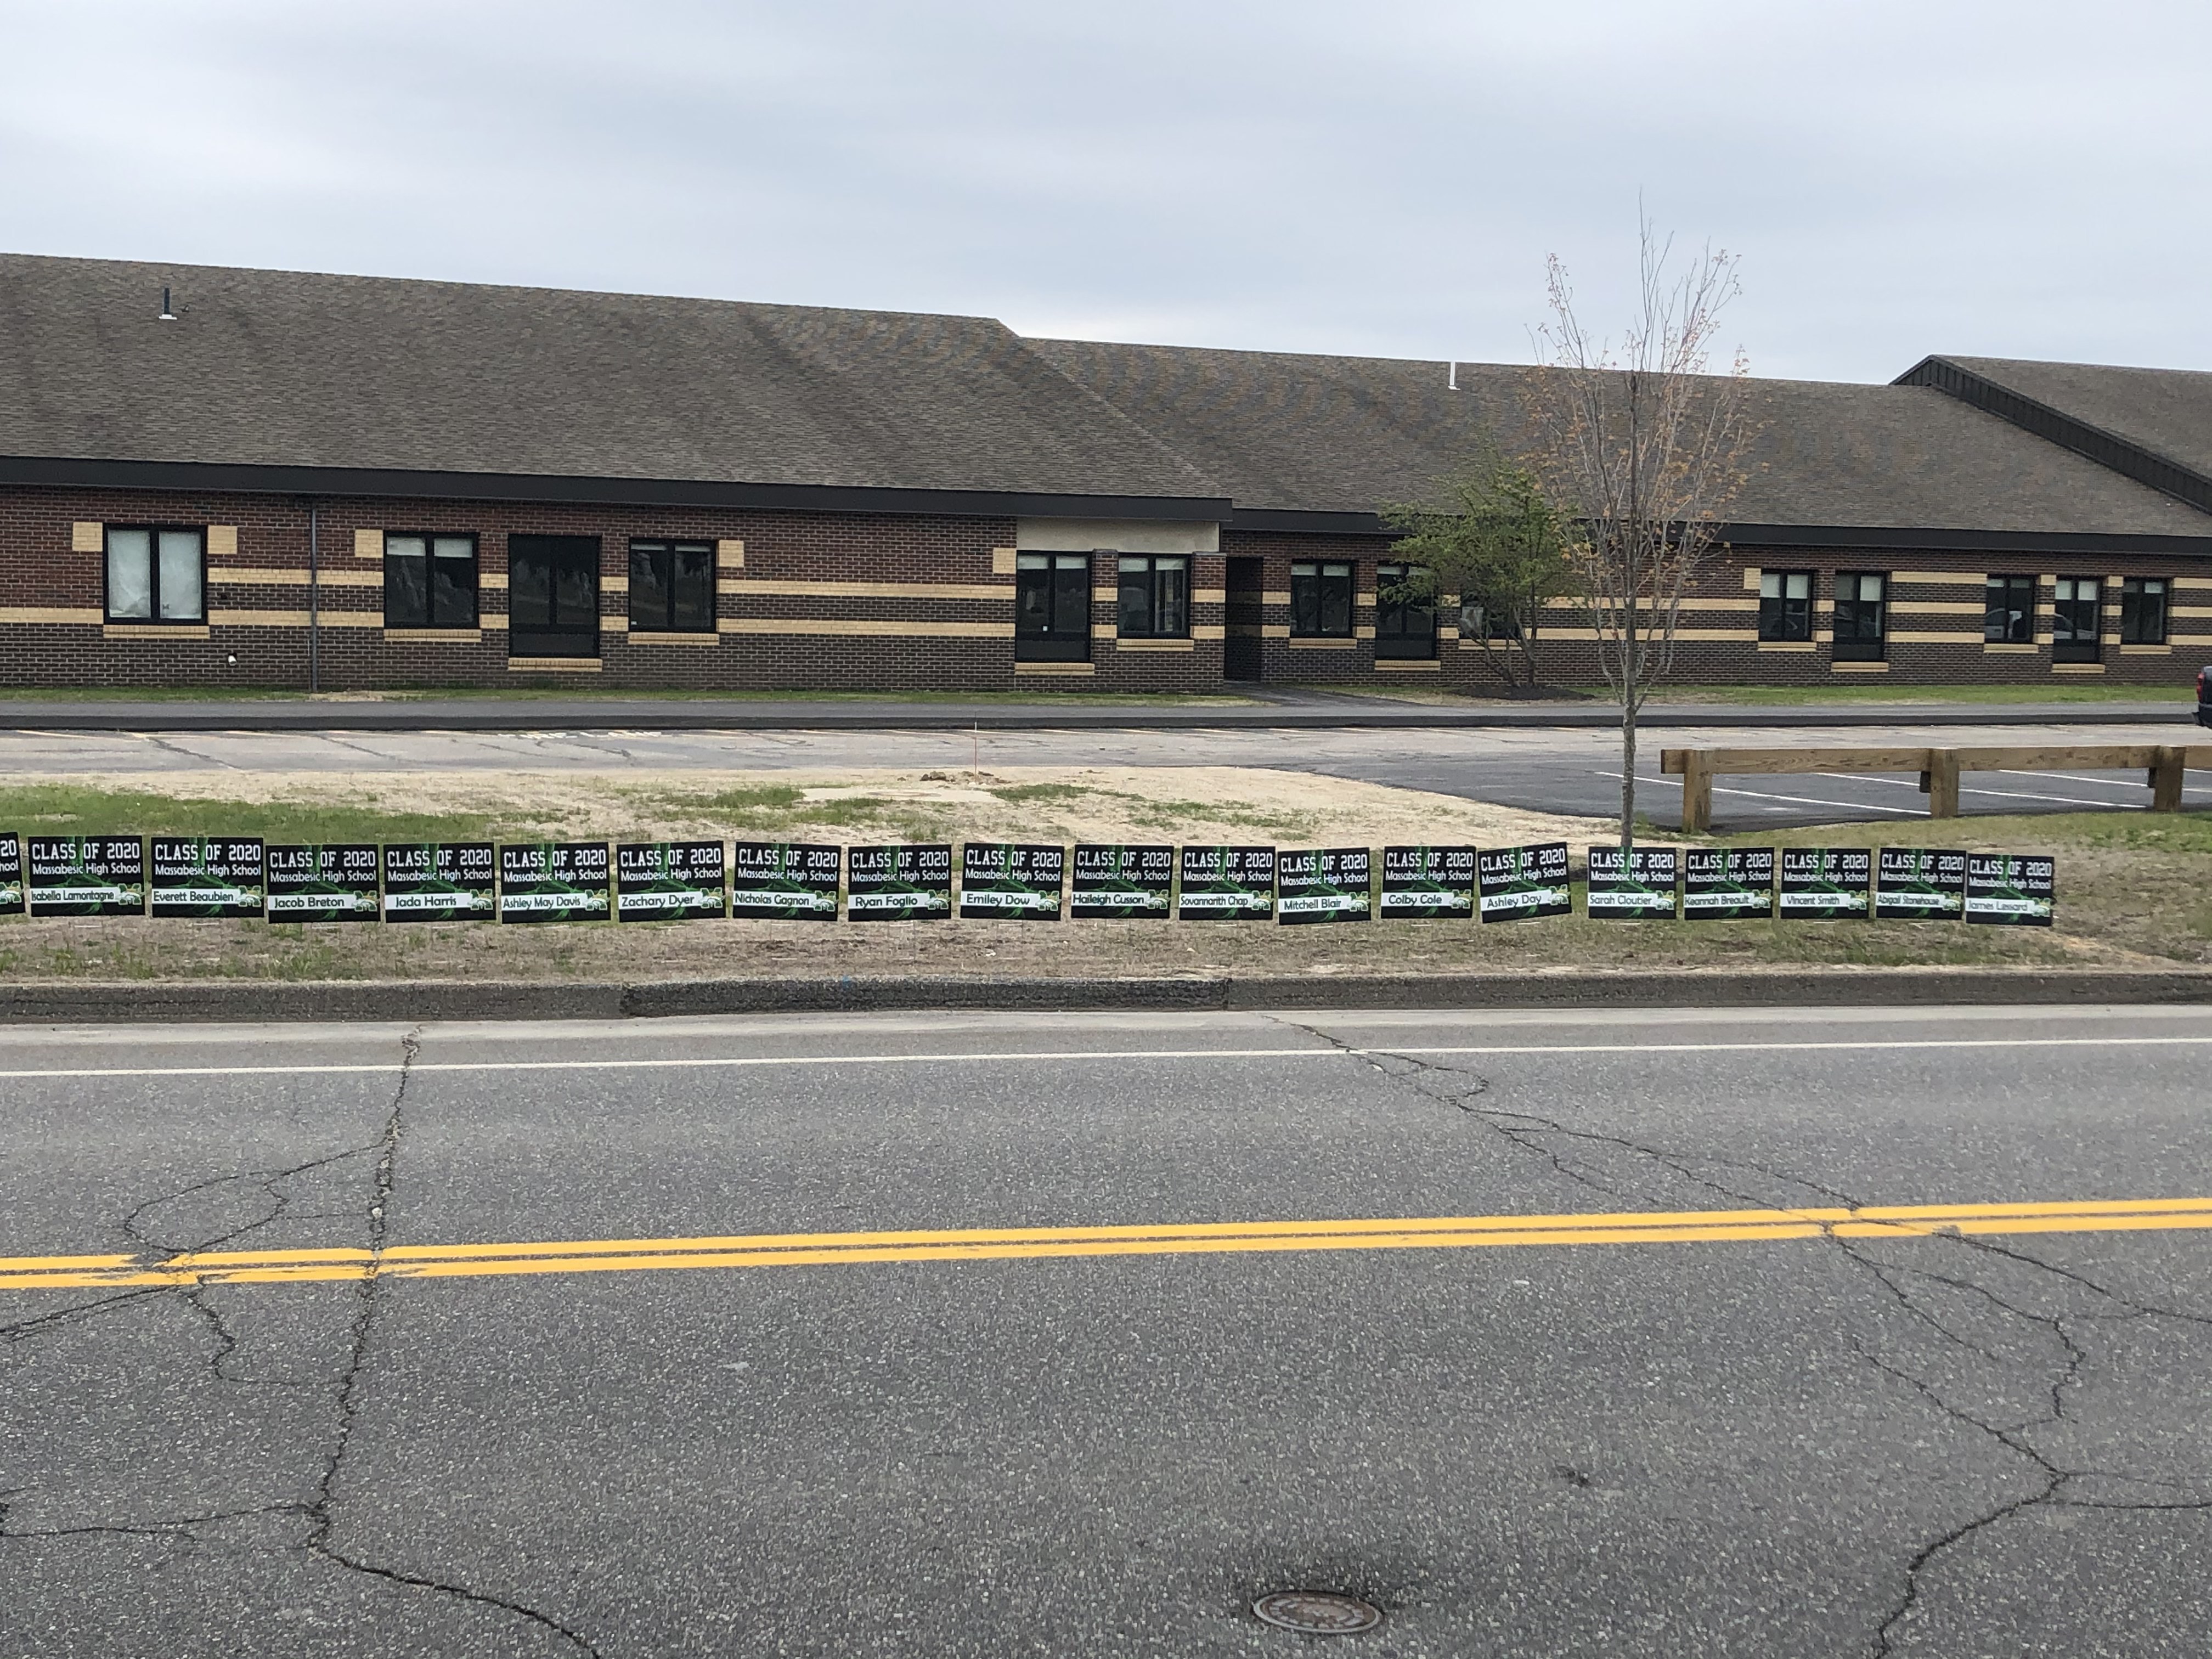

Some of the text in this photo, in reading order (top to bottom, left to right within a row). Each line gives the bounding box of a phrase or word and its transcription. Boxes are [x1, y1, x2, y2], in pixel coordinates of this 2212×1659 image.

[0, 839, 16, 857] 20
[32, 842, 140, 859] CLASS OF 2020
[154, 844, 261, 860] CLASS OF 2020
[269, 851, 376, 867] CLASS OF 2020
[387, 849, 492, 866] CLASS OF 2020
[503, 849, 606, 867] CLASS OF 2020
[620, 848, 721, 866] CLASS OF 2020
[738, 849, 838, 867] CLASS OF 2020
[851, 851, 949, 867] CLASS OF 2020
[966, 849, 1061, 867] CLASS OF 2020
[1077, 851, 1171, 867] CLASS OF 2020
[1184, 852, 1273, 867] CLASS OF 2020
[1280, 854, 1367, 872] CLASS OF 2020
[1386, 852, 1474, 867] CLASS OF 2020
[1481, 848, 1565, 872] CLASS OF 2020
[1591, 853, 1674, 868] CLASS OF 2020
[1689, 853, 1772, 870] CLASS OF 2020
[1785, 854, 1869, 868] CLASS OF 2020
[1882, 854, 1963, 870] CLASS OF 2020
[32, 862, 140, 876] Massabesic High School
[154, 864, 261, 877] Massabesic High School
[387, 868, 492, 882] Massabesic High School
[503, 867, 606, 882] Massabesic High School
[620, 866, 721, 881] Massabesic High School
[737, 867, 837, 882] Massabesic High School
[851, 869, 949, 882] Massabesic High School
[965, 867, 1060, 882] Massabesic High School
[1076, 869, 1170, 882] Massabesic High School
[1481, 865, 1566, 885] Massabesic High School
[1970, 860, 2052, 876] CLASS OF 2020
[269, 870, 376, 883] Massabesic High School
[1183, 870, 1272, 883] Massabesic High School
[1280, 871, 1368, 886] Massabesic High School
[1385, 870, 1472, 882] Massabesic High School
[1632, 871, 1674, 883] High School
[1728, 871, 1746, 883] High
[1748, 871, 1771, 882] School
[1825, 871, 1868, 883] High School
[1921, 872, 1962, 884] High School
[2010, 878, 2051, 890] High School
[31, 889, 114, 902] Isabella Lamontagne
[154, 891, 233, 901] Everett Beaubien
[274, 896, 344, 908] Jacob Breton
[395, 895, 456, 907] Jada Harris
[503, 895, 580, 910] Ashley May Davis
[622, 894, 694, 909] Zachary Dyer
[735, 893, 809, 906] Nicholas Gagnon
[855, 895, 917, 909] Ryan Foglio
[966, 893, 1030, 906] Emiley Dow
[1073, 894, 1144, 905] Haileigh Cusson
[1228, 896, 1248, 906] Chap
[1388, 895, 1442, 906] Colby Cole
[1486, 893, 1542, 910] Ashley Day
[1590, 895, 1652, 904] Sarah Cloutier
[1786, 895, 1839, 904] Vincent Smith
[1284, 898, 1341, 910] Mitchell Blair
